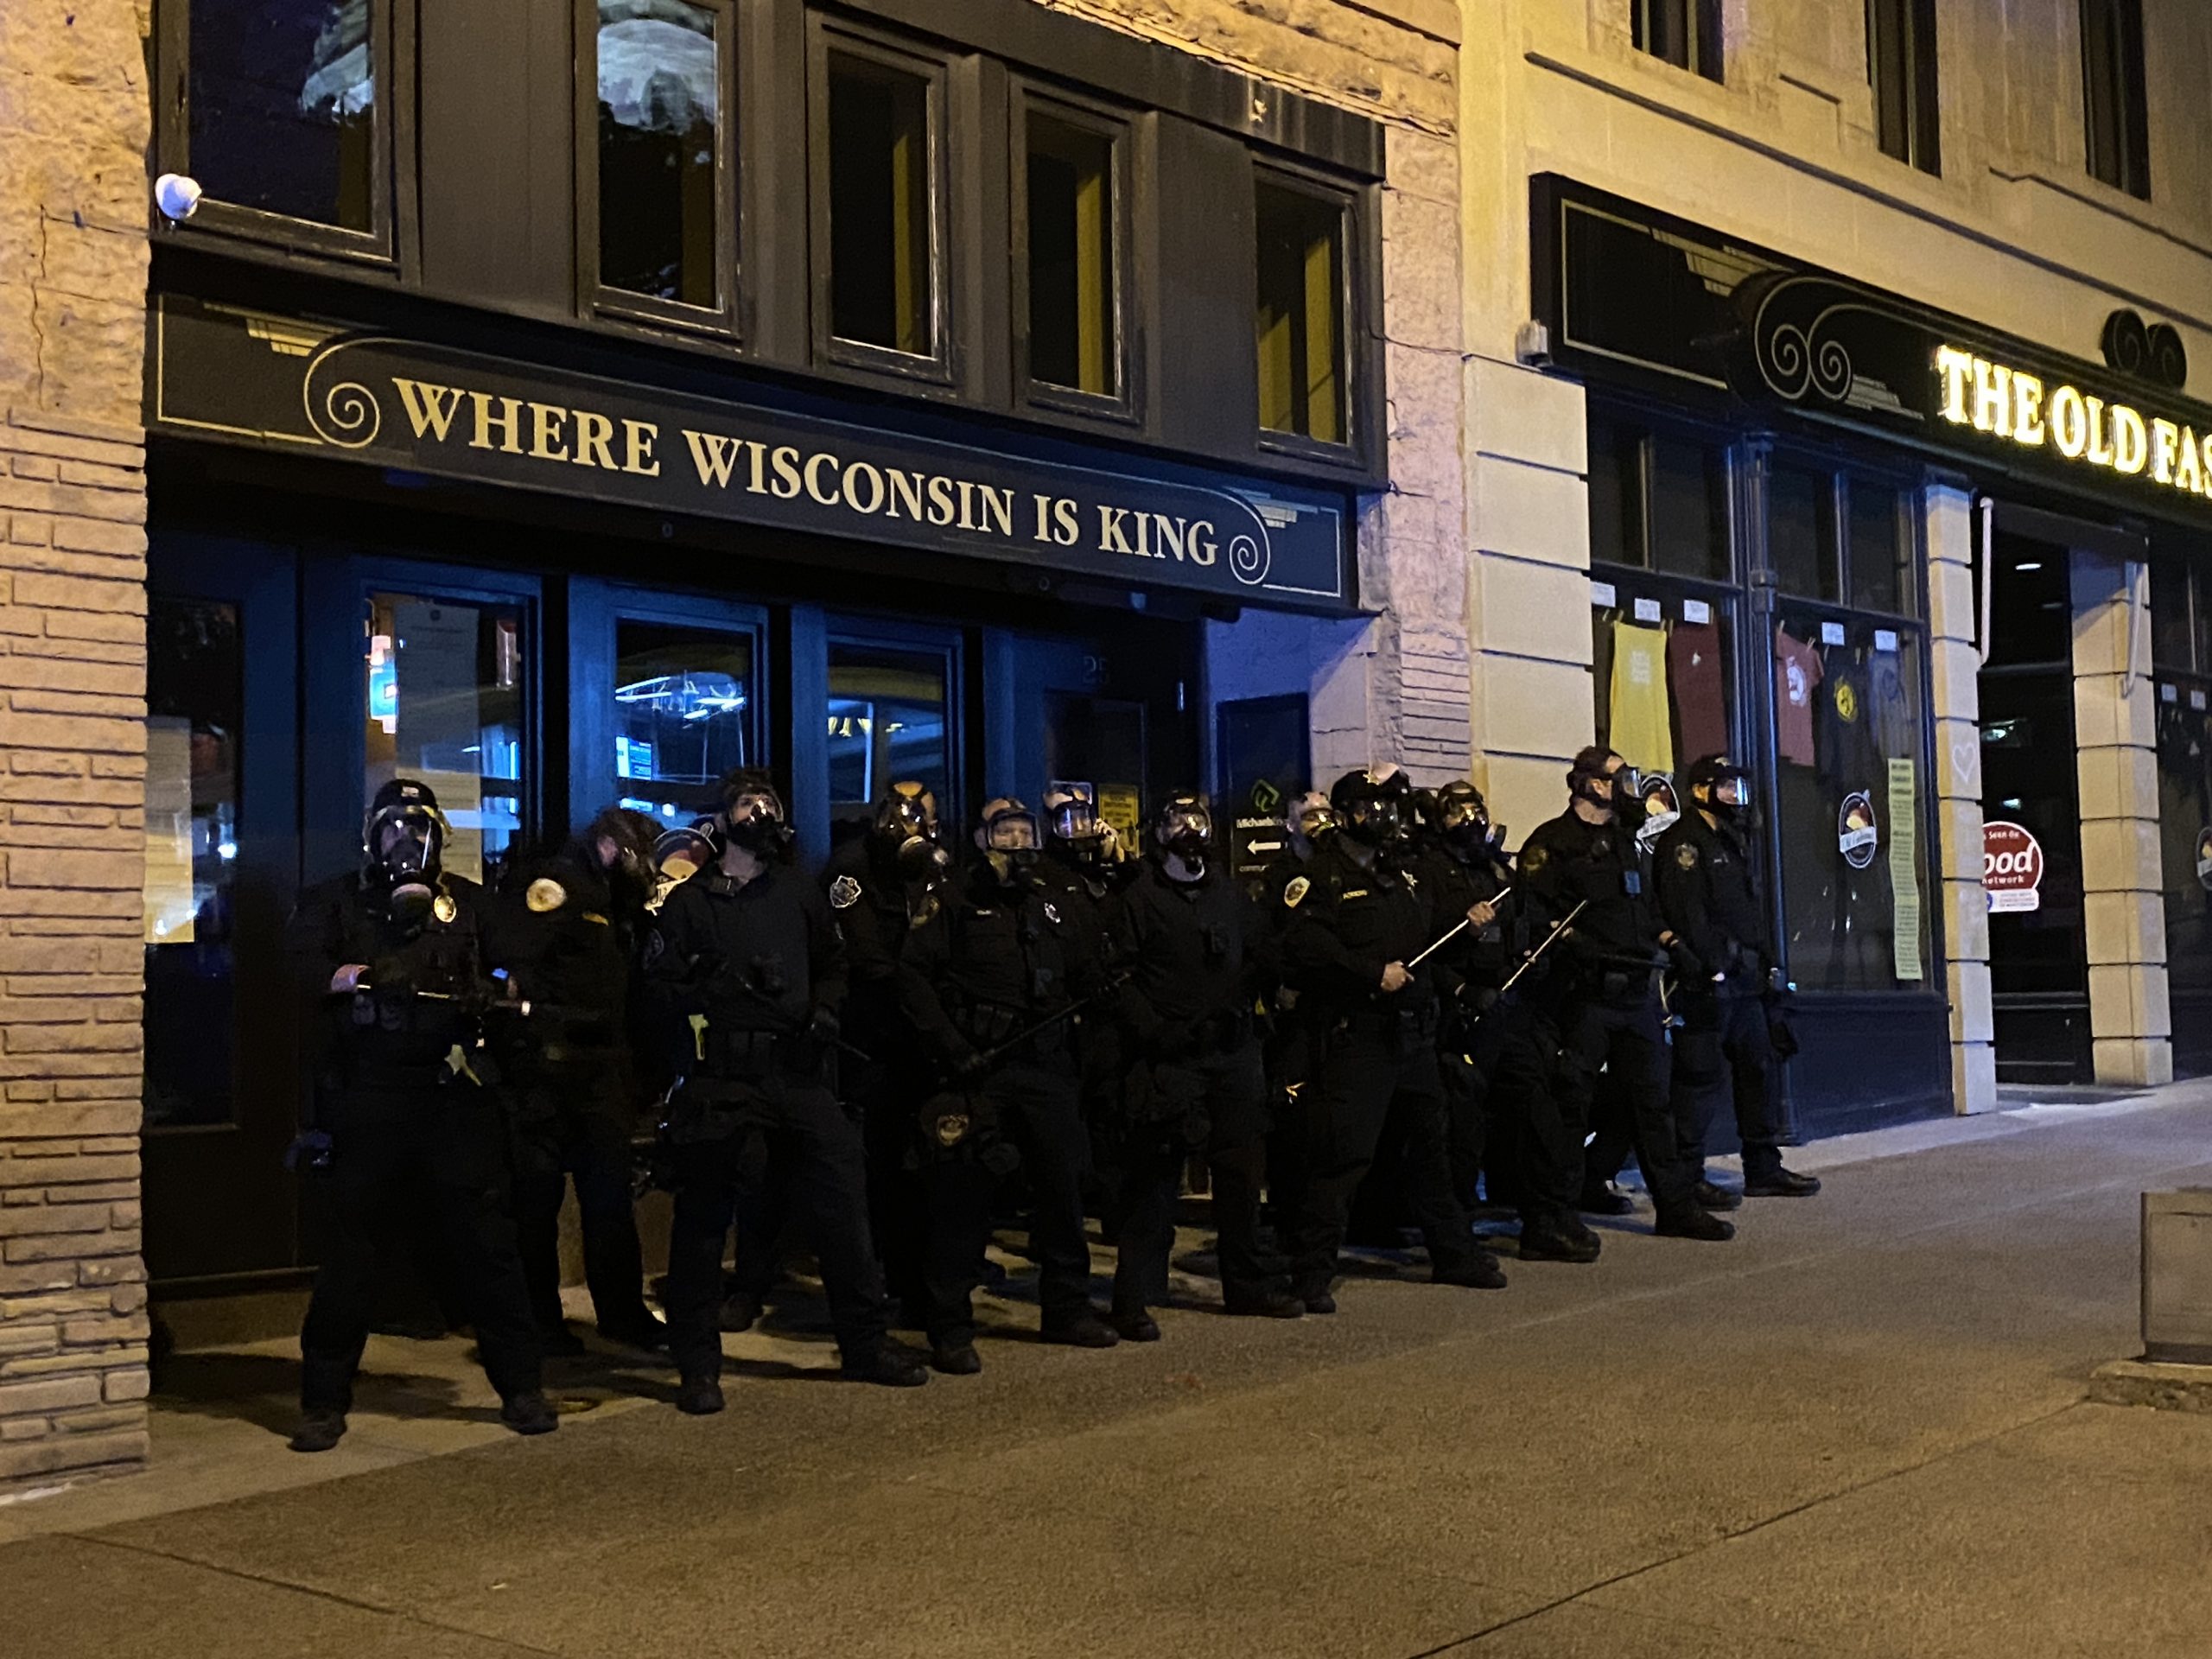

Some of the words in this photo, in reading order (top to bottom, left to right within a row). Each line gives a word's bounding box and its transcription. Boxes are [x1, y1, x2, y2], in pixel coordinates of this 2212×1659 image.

[1934, 344, 2045, 445] THE
[2051, 385, 2147, 474] OLD
[391, 377, 660, 477] WHERE
[681, 428, 1015, 537] WISCONSIN
[1033, 493, 1080, 547] IS
[1096, 505, 1218, 567] KING
[1984, 842, 2033, 874] ood
[1988, 830, 2007, 839] Seen
